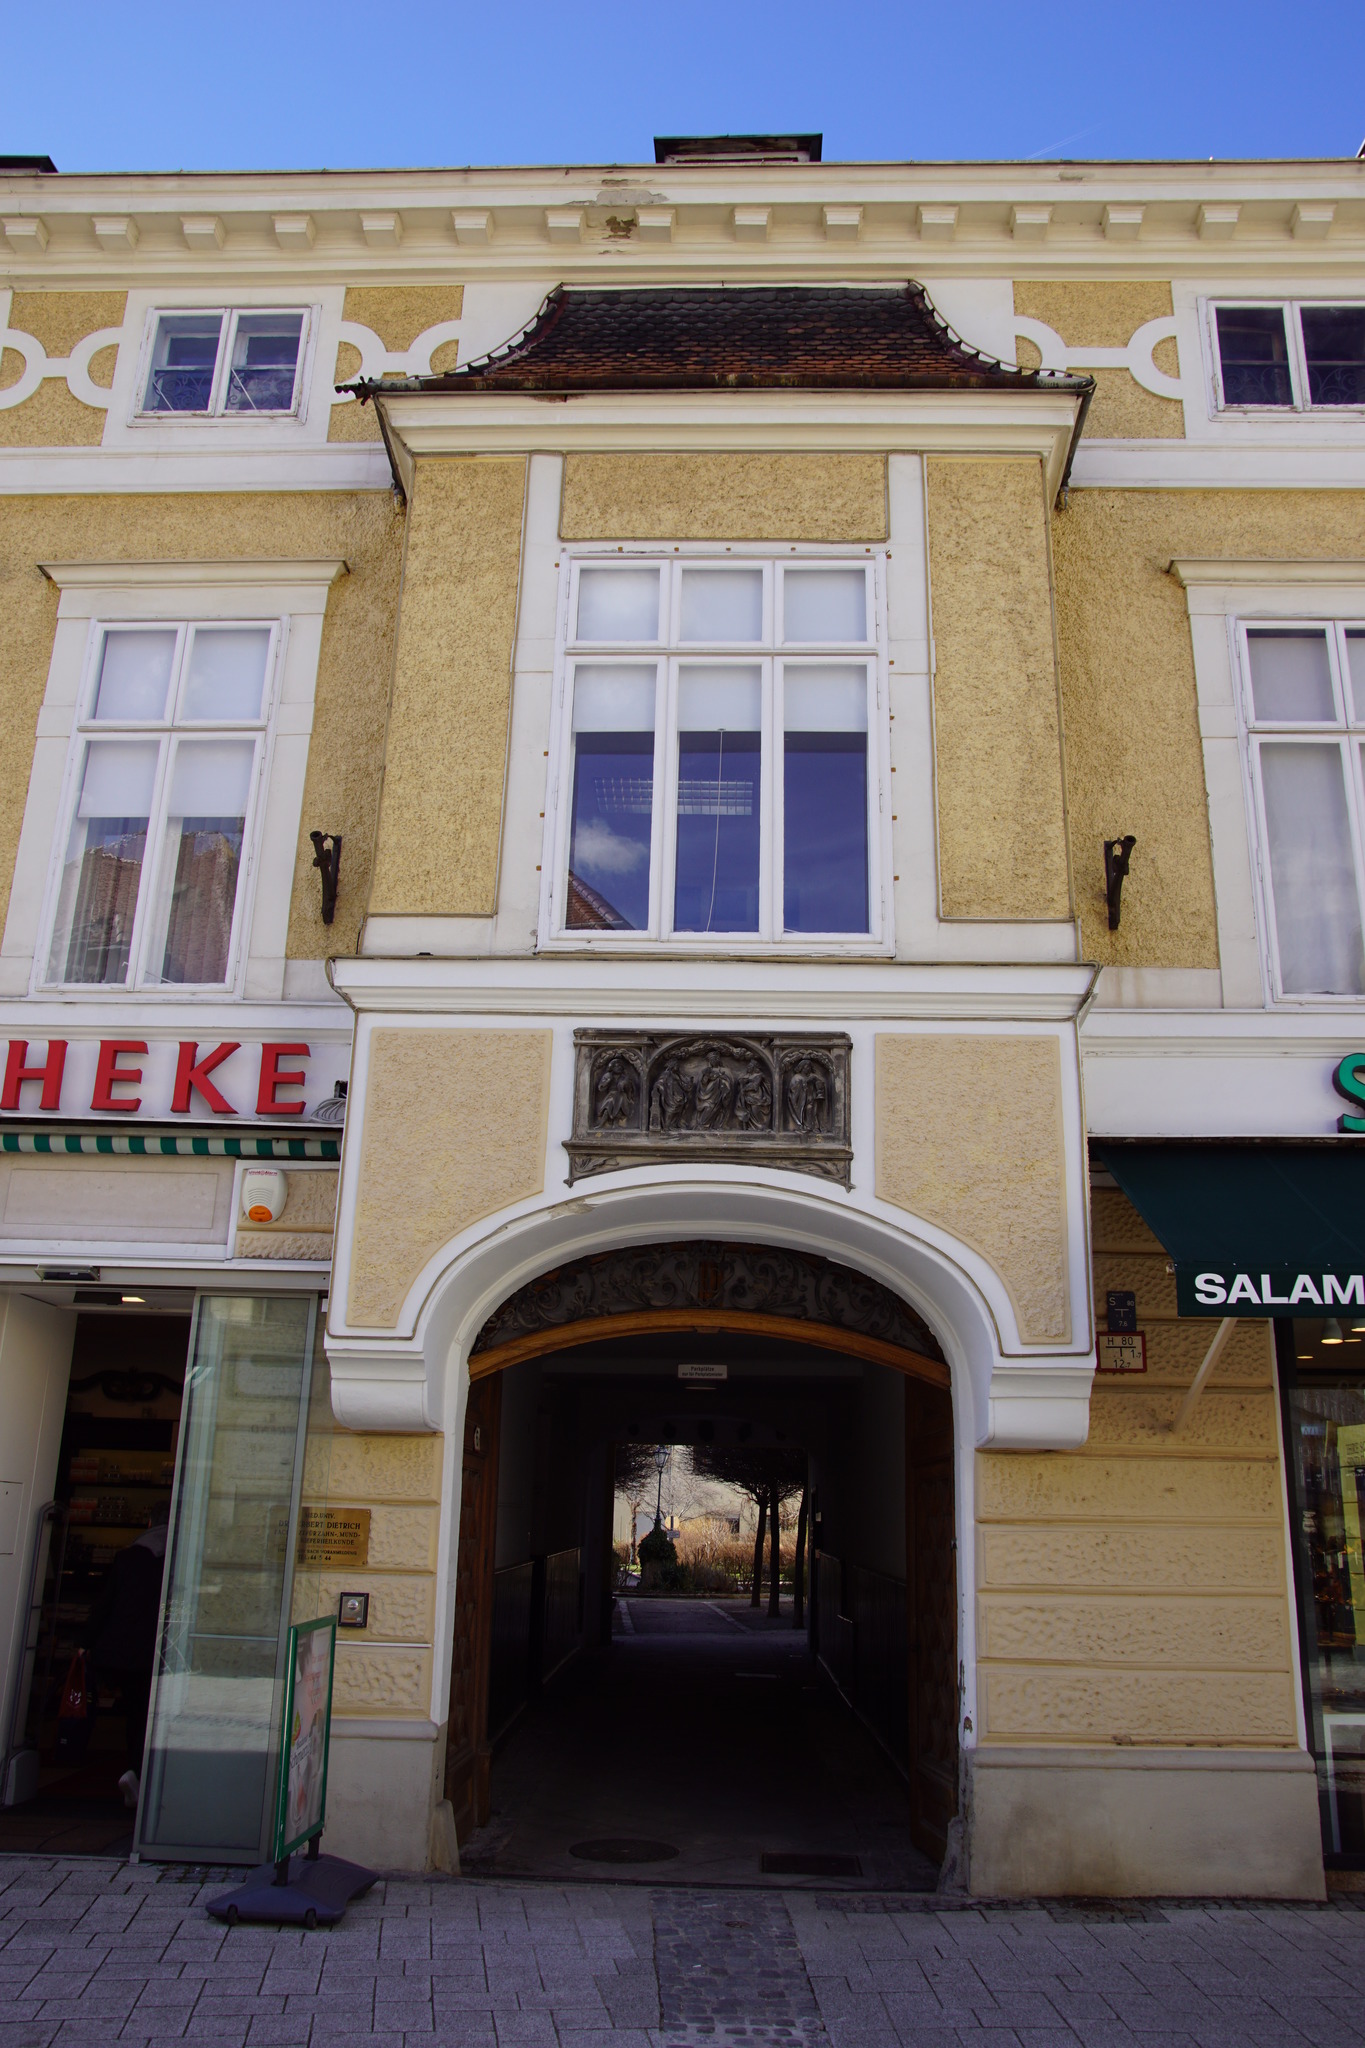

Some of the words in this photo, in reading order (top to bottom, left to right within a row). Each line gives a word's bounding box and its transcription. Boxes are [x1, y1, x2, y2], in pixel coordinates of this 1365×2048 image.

[0, 1040, 311, 1115] HEKE
[1195, 1273, 1365, 1304] SALAM
[1109, 1297, 1116, 1306] S
[1107, 1337, 1114, 1345] H
[1122, 1337, 1133, 1345] 80
[327, 1522, 361, 1530] DIETRICH
